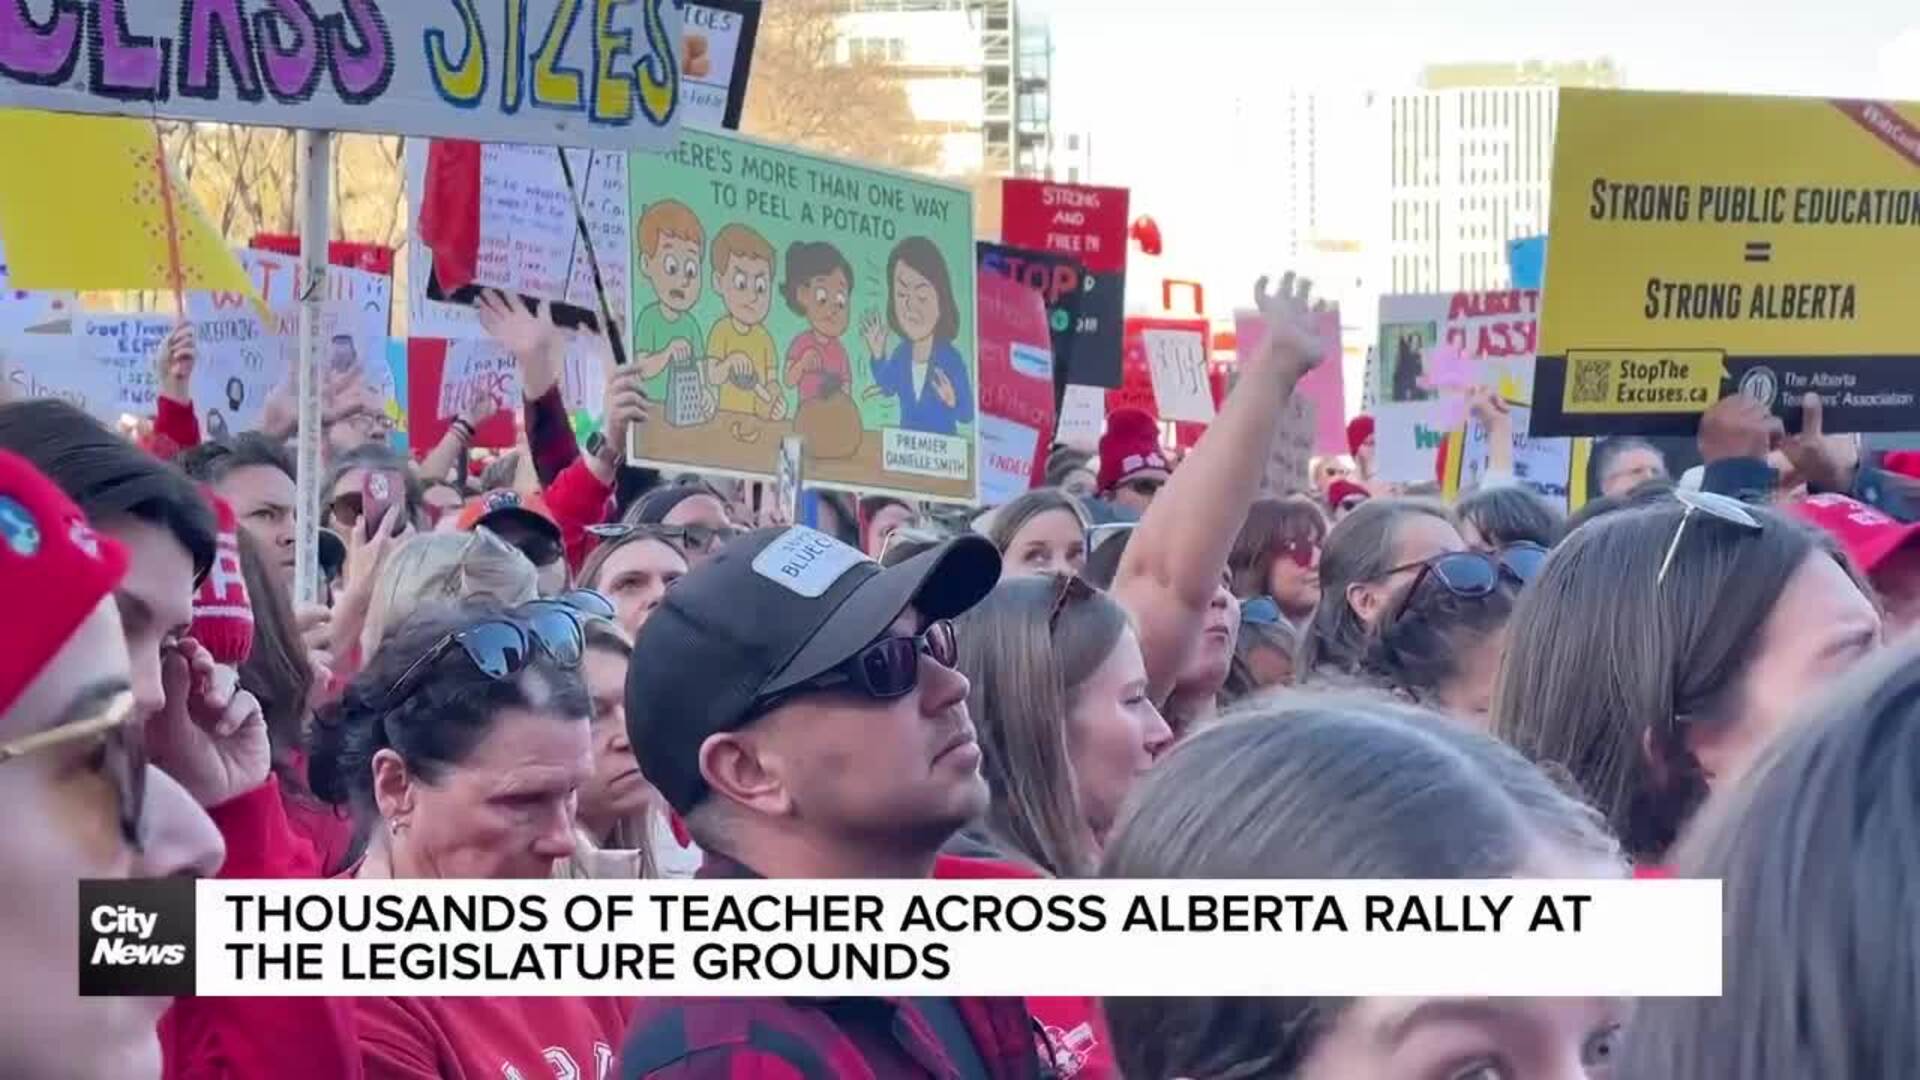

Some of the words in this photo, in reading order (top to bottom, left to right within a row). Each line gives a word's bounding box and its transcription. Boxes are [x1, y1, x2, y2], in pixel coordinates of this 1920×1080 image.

[424, 0, 679, 127] SIZES
[741, 155, 798, 193] MORE
[807, 170, 860, 203] THAN
[867, 184, 904, 212] ONE
[912, 194, 949, 222] WAY
[1590, 177, 1690, 222] STRONG
[1698, 186, 1786, 223] PUBLIC
[1793, 188, 1920, 225] EDUCATION
[710, 180, 737, 207] TO
[746, 188, 792, 222] PEEL
[801, 202, 815, 224] A
[821, 206, 897, 241] POTATO
[1645, 278, 1742, 319] STRONG
[1749, 285, 1855, 320] ALBERTA
[1620, 359, 1689, 381] StopThe
[1785, 371, 1807, 387] The
[1811, 371, 1858, 387] Alberta
[1616, 383, 1708, 403] Excuses.ca
[1781, 392, 1841, 408] Teaers'
[1842, 392, 1915, 408] Association
[893, 433, 948, 455] PREMIER
